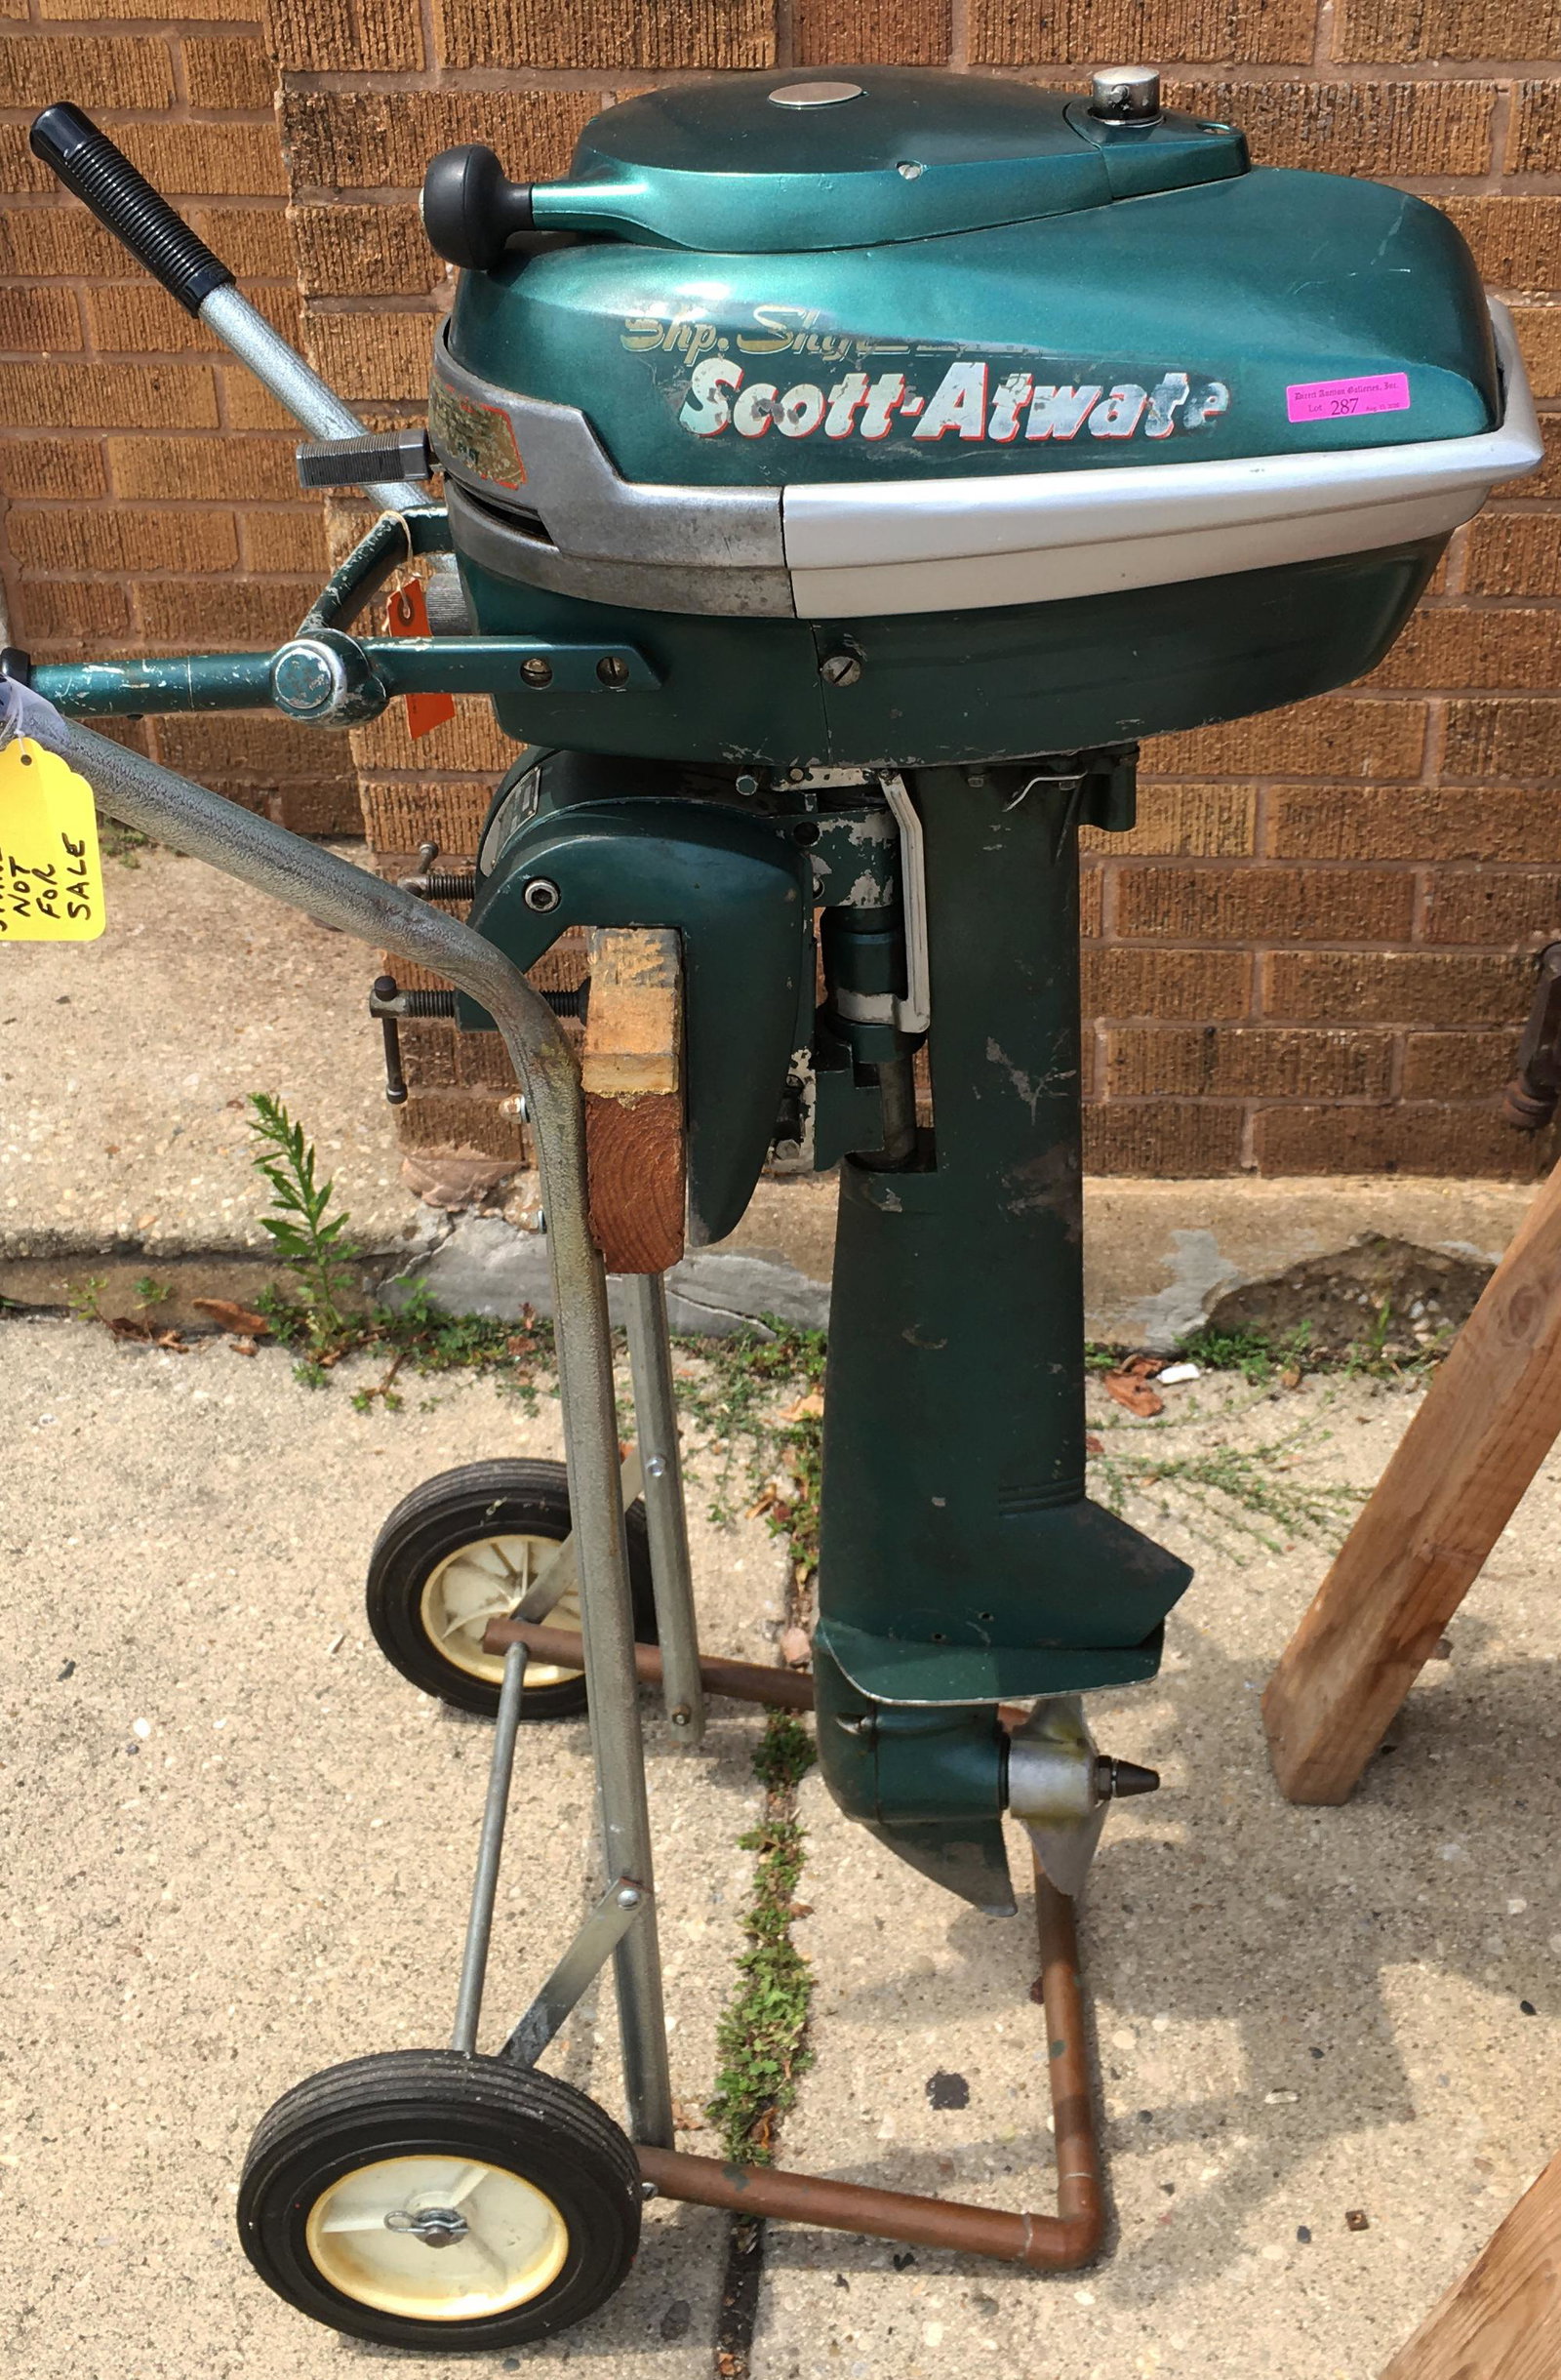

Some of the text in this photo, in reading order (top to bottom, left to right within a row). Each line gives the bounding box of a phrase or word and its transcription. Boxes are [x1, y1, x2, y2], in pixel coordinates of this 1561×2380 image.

[1308, 398, 1359, 416] Lot 287
[8, 856, 31, 917] NOT
[31, 864, 60, 919] FOR
[61, 832, 91, 920] SALE
